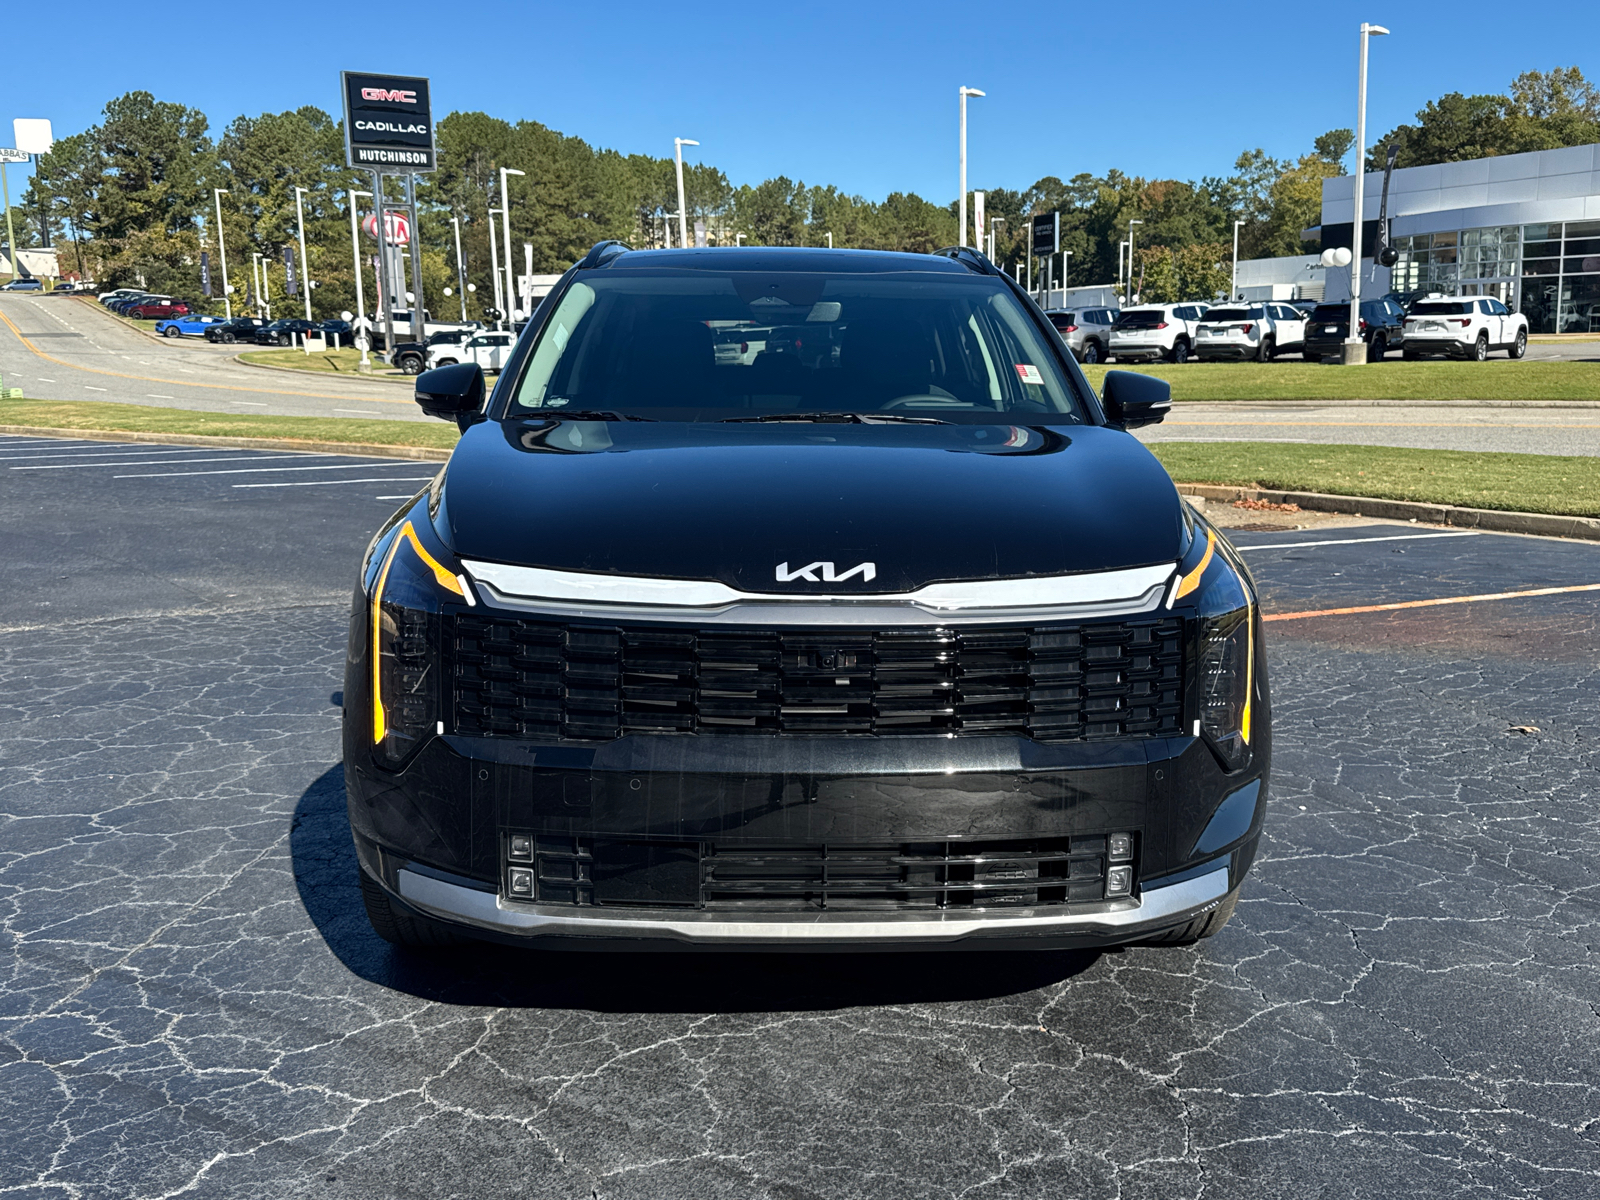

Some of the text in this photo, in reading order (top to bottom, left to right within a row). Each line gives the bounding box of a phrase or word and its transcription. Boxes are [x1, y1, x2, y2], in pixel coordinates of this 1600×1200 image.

[361, 87, 417, 104] GMC
[355, 120, 427, 134] CADILLAC
[359, 149, 427, 164] HUTCHINSON
[775, 561, 876, 582] KIA
